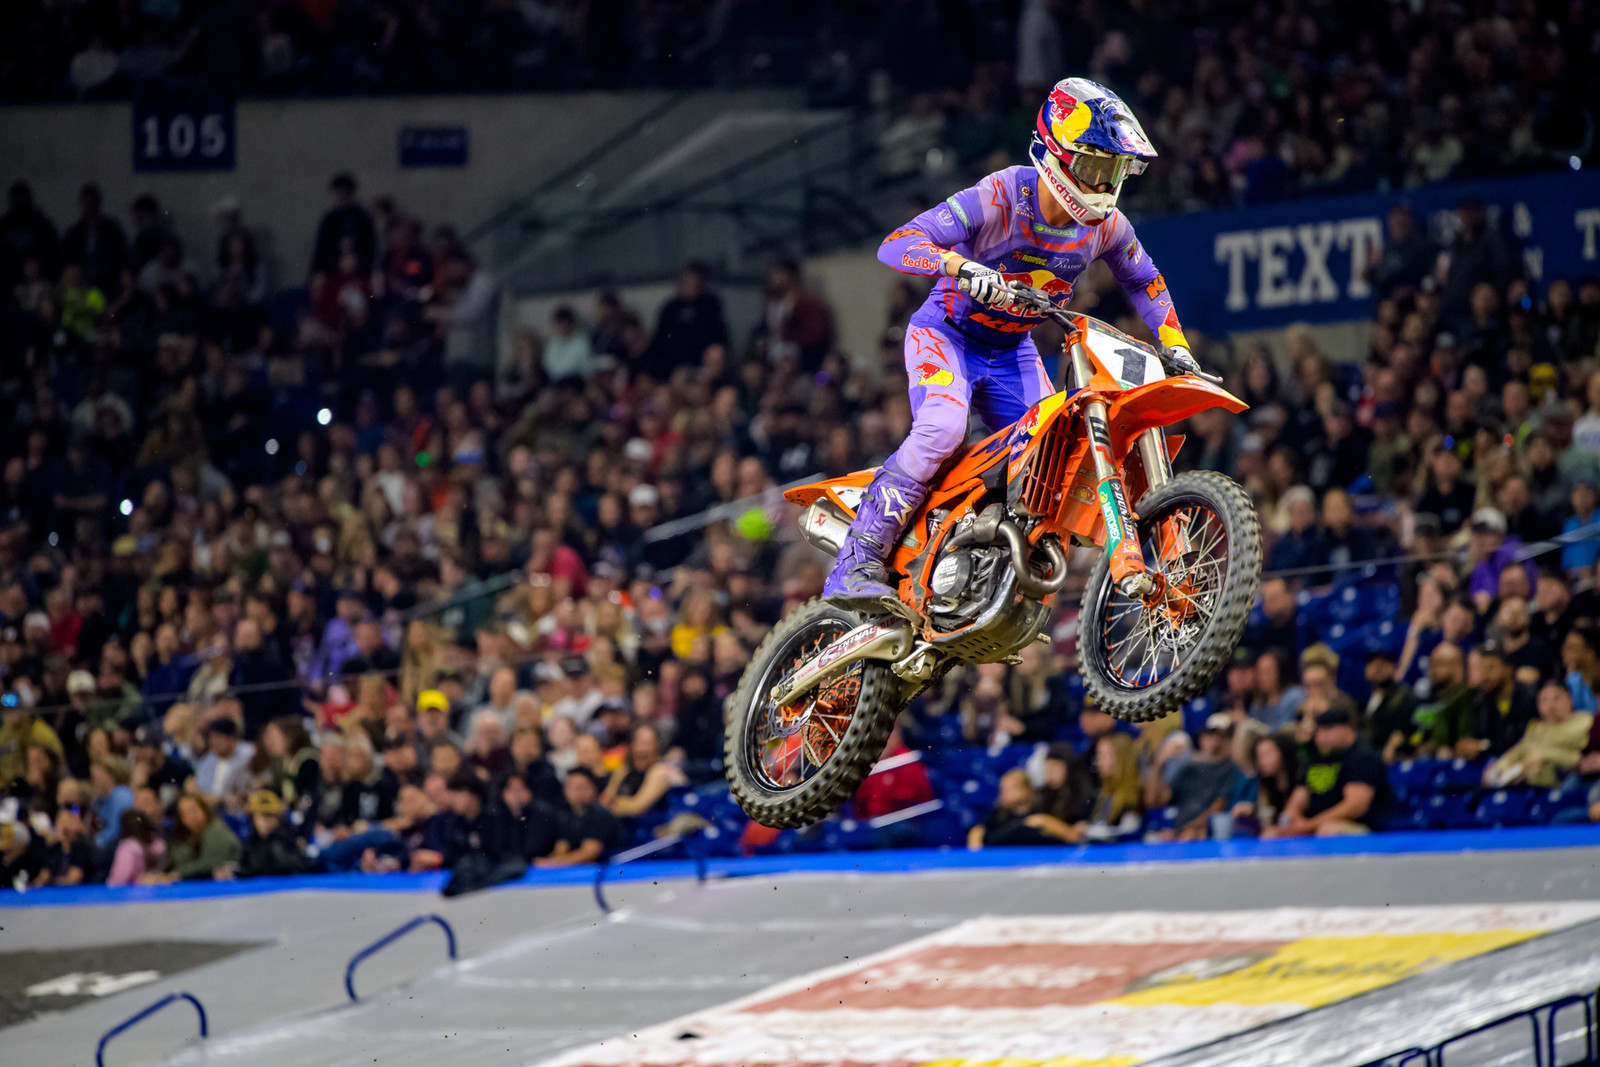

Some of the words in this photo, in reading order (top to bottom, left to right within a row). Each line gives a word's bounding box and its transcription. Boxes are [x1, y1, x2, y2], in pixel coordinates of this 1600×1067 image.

[142, 113, 226, 159] 105
[902, 254, 921, 268] Red
[1215, 217, 1383, 312] TEXT
[1114, 348, 1147, 387] 1
[1102, 501, 1121, 543] MOTOREX
[1114, 490, 1137, 541] DUNLOP
[819, 626, 877, 668] RENTHAL
